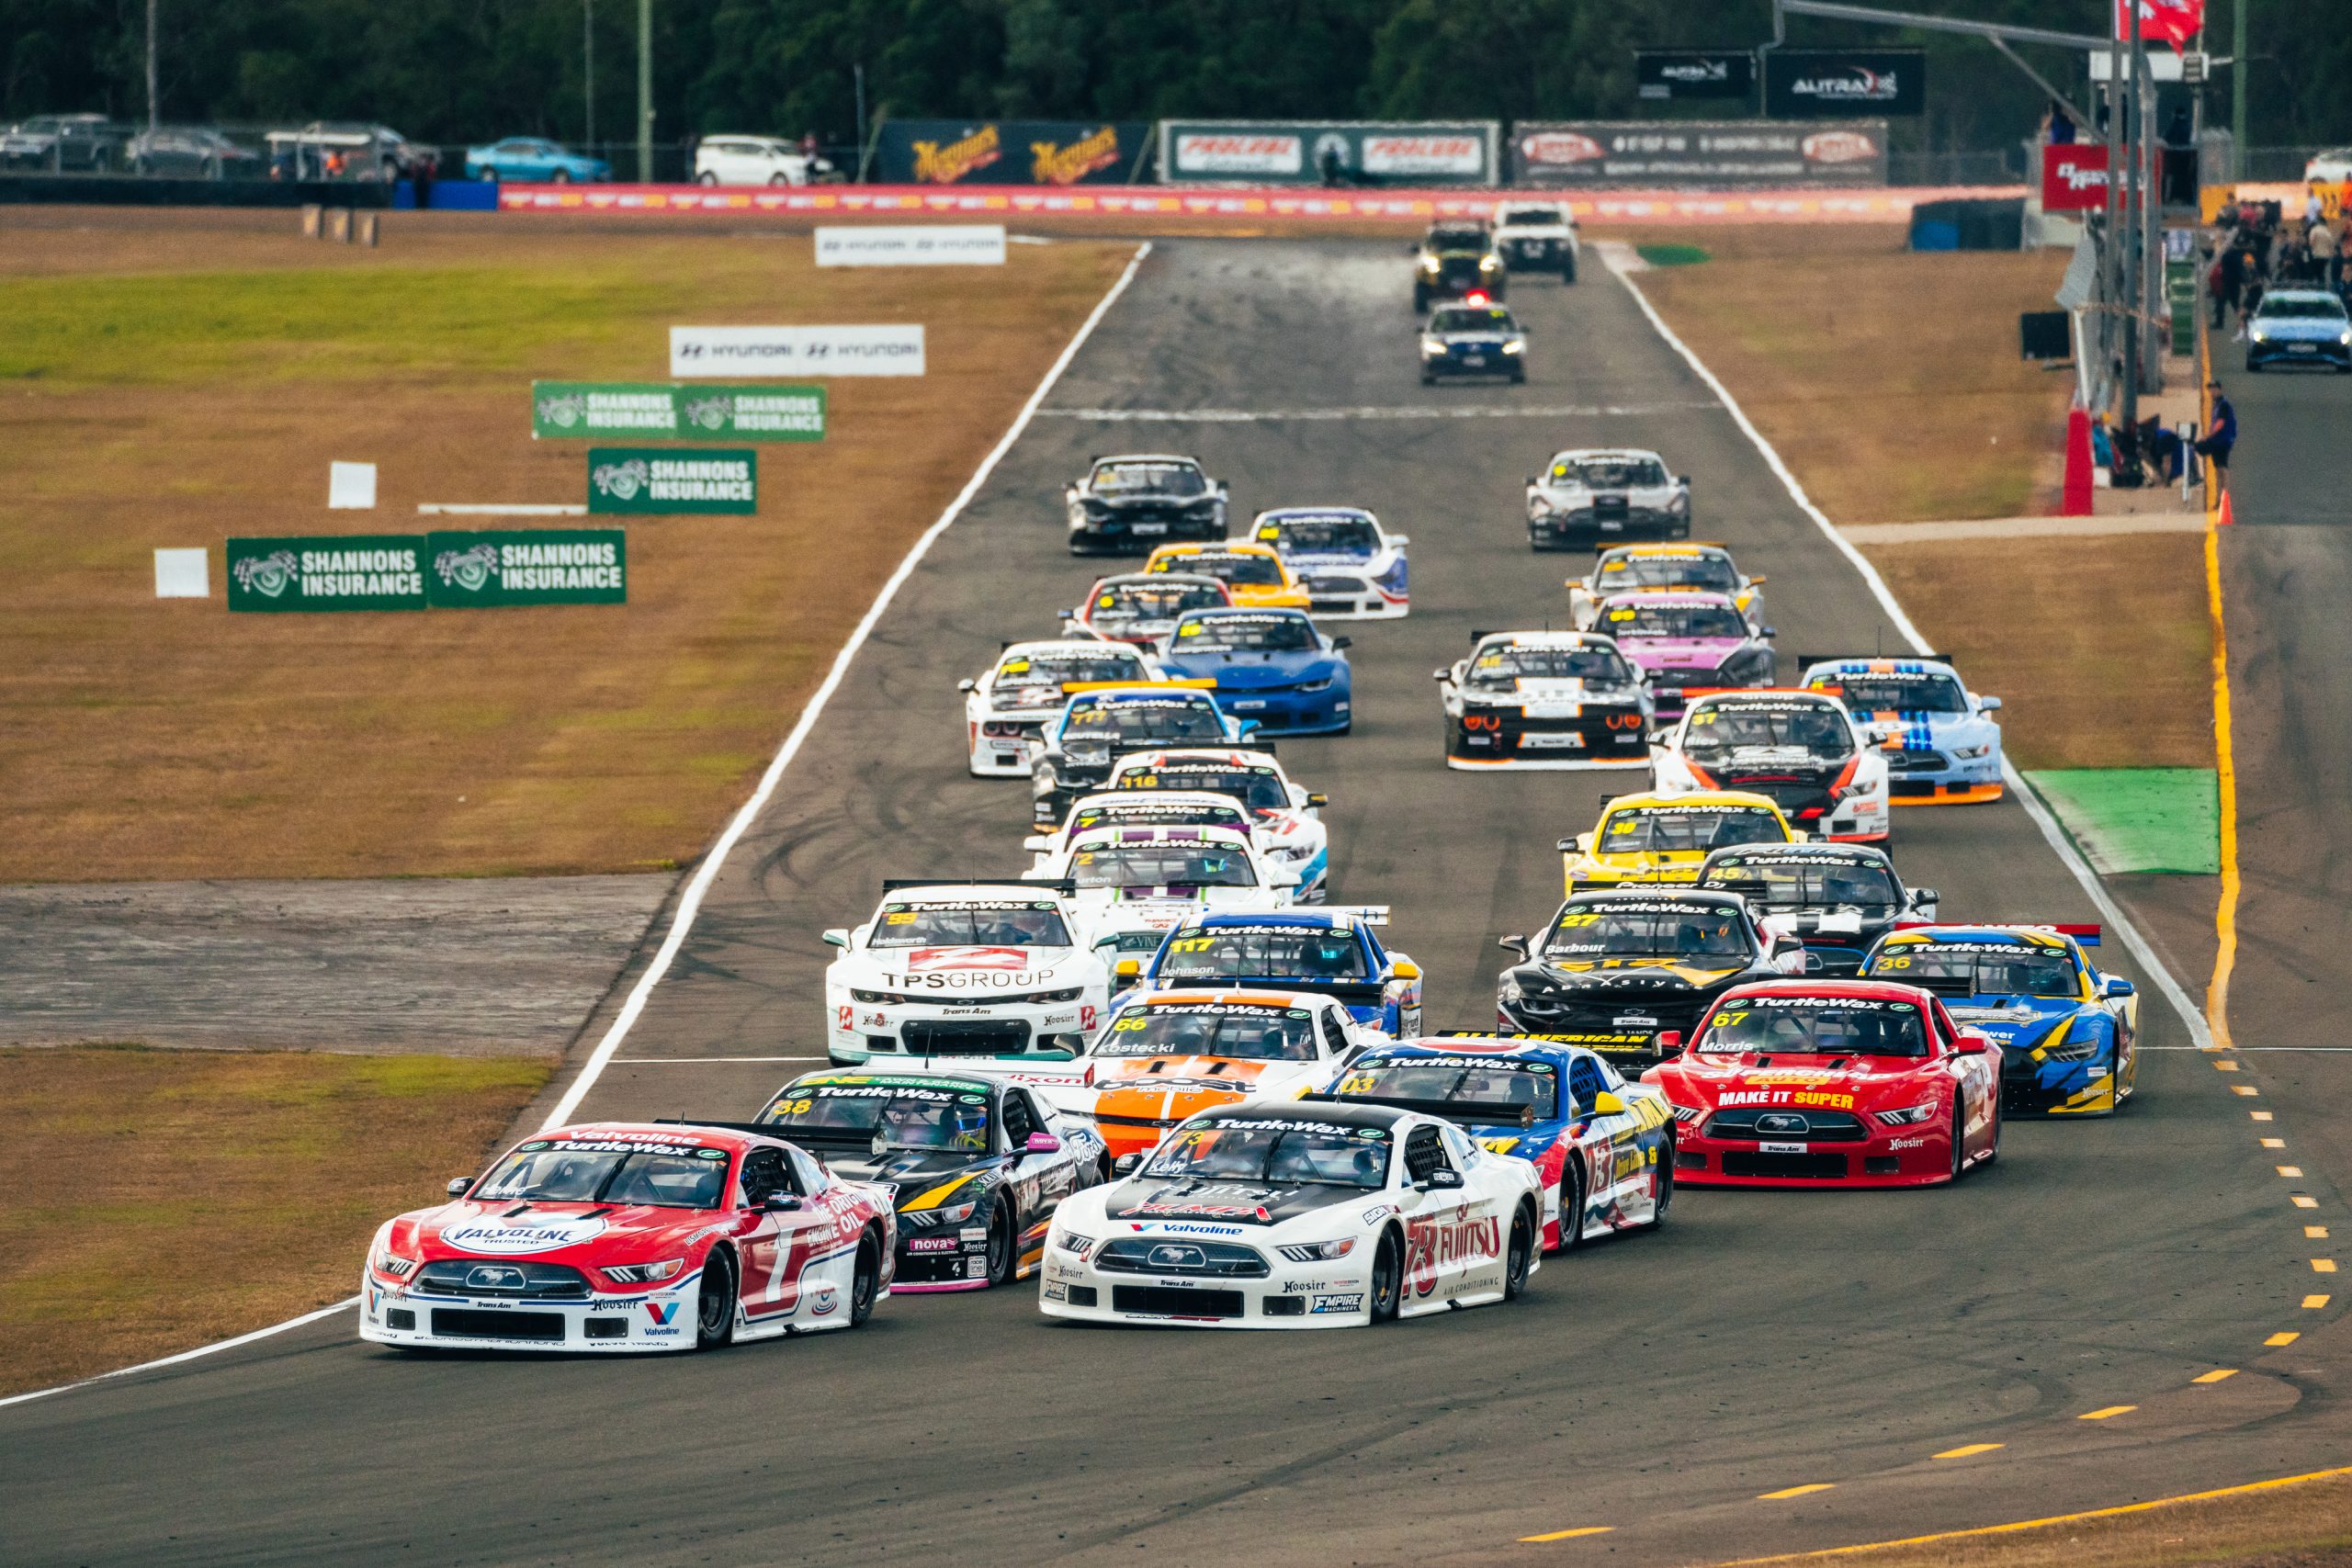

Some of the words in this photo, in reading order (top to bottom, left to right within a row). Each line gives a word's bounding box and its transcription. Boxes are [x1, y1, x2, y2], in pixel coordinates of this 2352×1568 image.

[712, 344, 792, 356] HYUNDAI
[838, 344, 918, 355] HYUNDAI
[587, 392, 672, 411] SHANNONS
[734, 396, 819, 413] SHANNONS
[587, 411, 677, 428] INSURANCE
[734, 413, 824, 431] INSURANCE
[650, 460, 749, 480] SHANNONS
[650, 480, 753, 501] INSURANCE
[301, 550, 416, 573] SHANNONS
[502, 544, 616, 567] SHANNONS
[301, 572, 423, 596] INSURANCE
[502, 566, 622, 590] INSURANCE
[1121, 775, 1158, 789] 116
[1077, 852, 1094, 865] 2
[1745, 856, 1859, 866] TurtleWax
[1707, 867, 1738, 881] 45
[1615, 882, 1699, 890] Pioneer
[910, 901, 1029, 913] TurtleWax
[1591, 903, 1710, 915] TurtleWax
[886, 912, 919, 925] 99
[1559, 914, 1600, 928] 27
[1205, 925, 1325, 937] TurtleWax
[1170, 938, 1215, 953] 117
[1544, 942, 1606, 954] Barbour
[1913, 942, 2038, 955] TurtleWax
[1877, 956, 1911, 971] 36
[1159, 965, 1216, 977] Johnson
[1153, 1004, 1282, 1018] TurtleWax
[1754, 998, 1883, 1010] TurtleWax
[1114, 1017, 1148, 1032] 66
[1713, 1012, 1749, 1027] 67
[1510, 1032, 1649, 1043] AMERICAN
[1100, 1042, 1176, 1054] Kostecki
[1699, 1041, 1754, 1053] Morris
[1387, 1056, 1521, 1071] TurtleWax
[1093, 1078, 1257, 1093] boost
[1138, 1085, 1203, 1093] mobile
[1340, 1077, 1376, 1093] 03
[818, 1087, 954, 1101] TurtleWax
[1718, 1091, 1769, 1106] MAKE
[1772, 1091, 1792, 1102] IT
[1794, 1091, 1854, 1109] SUPER
[773, 1099, 812, 1115] 38
[1216, 1119, 1353, 1136] TurtleWax
[570, 1131, 703, 1145] Valvoline
[1889, 1138, 1925, 1150] Hoosier
[551, 1140, 693, 1156] TurtleWax
[1069, 1134, 1102, 1166] Ford
[1148, 1160, 1188, 1173] Kelly
[455, 1228, 575, 1243] VALVOLINE
[807, 1221, 841, 1247] ENGINE
[841, 1212, 865, 1233] OIL
[1163, 1224, 1243, 1235] Valvoline
[914, 1239, 947, 1249] nova
[1402, 1214, 1439, 1301] 73
[765, 1227, 796, 1303] 1
[1058, 1265, 1084, 1279] Hoosier
[1281, 1280, 1326, 1293] Hoosier
[1455, 1277, 1498, 1293] CONDITIONING
[591, 1299, 639, 1312] Hoosier
[1315, 1293, 1362, 1307] EMPIRE
[645, 1327, 680, 1337] Valvoline
